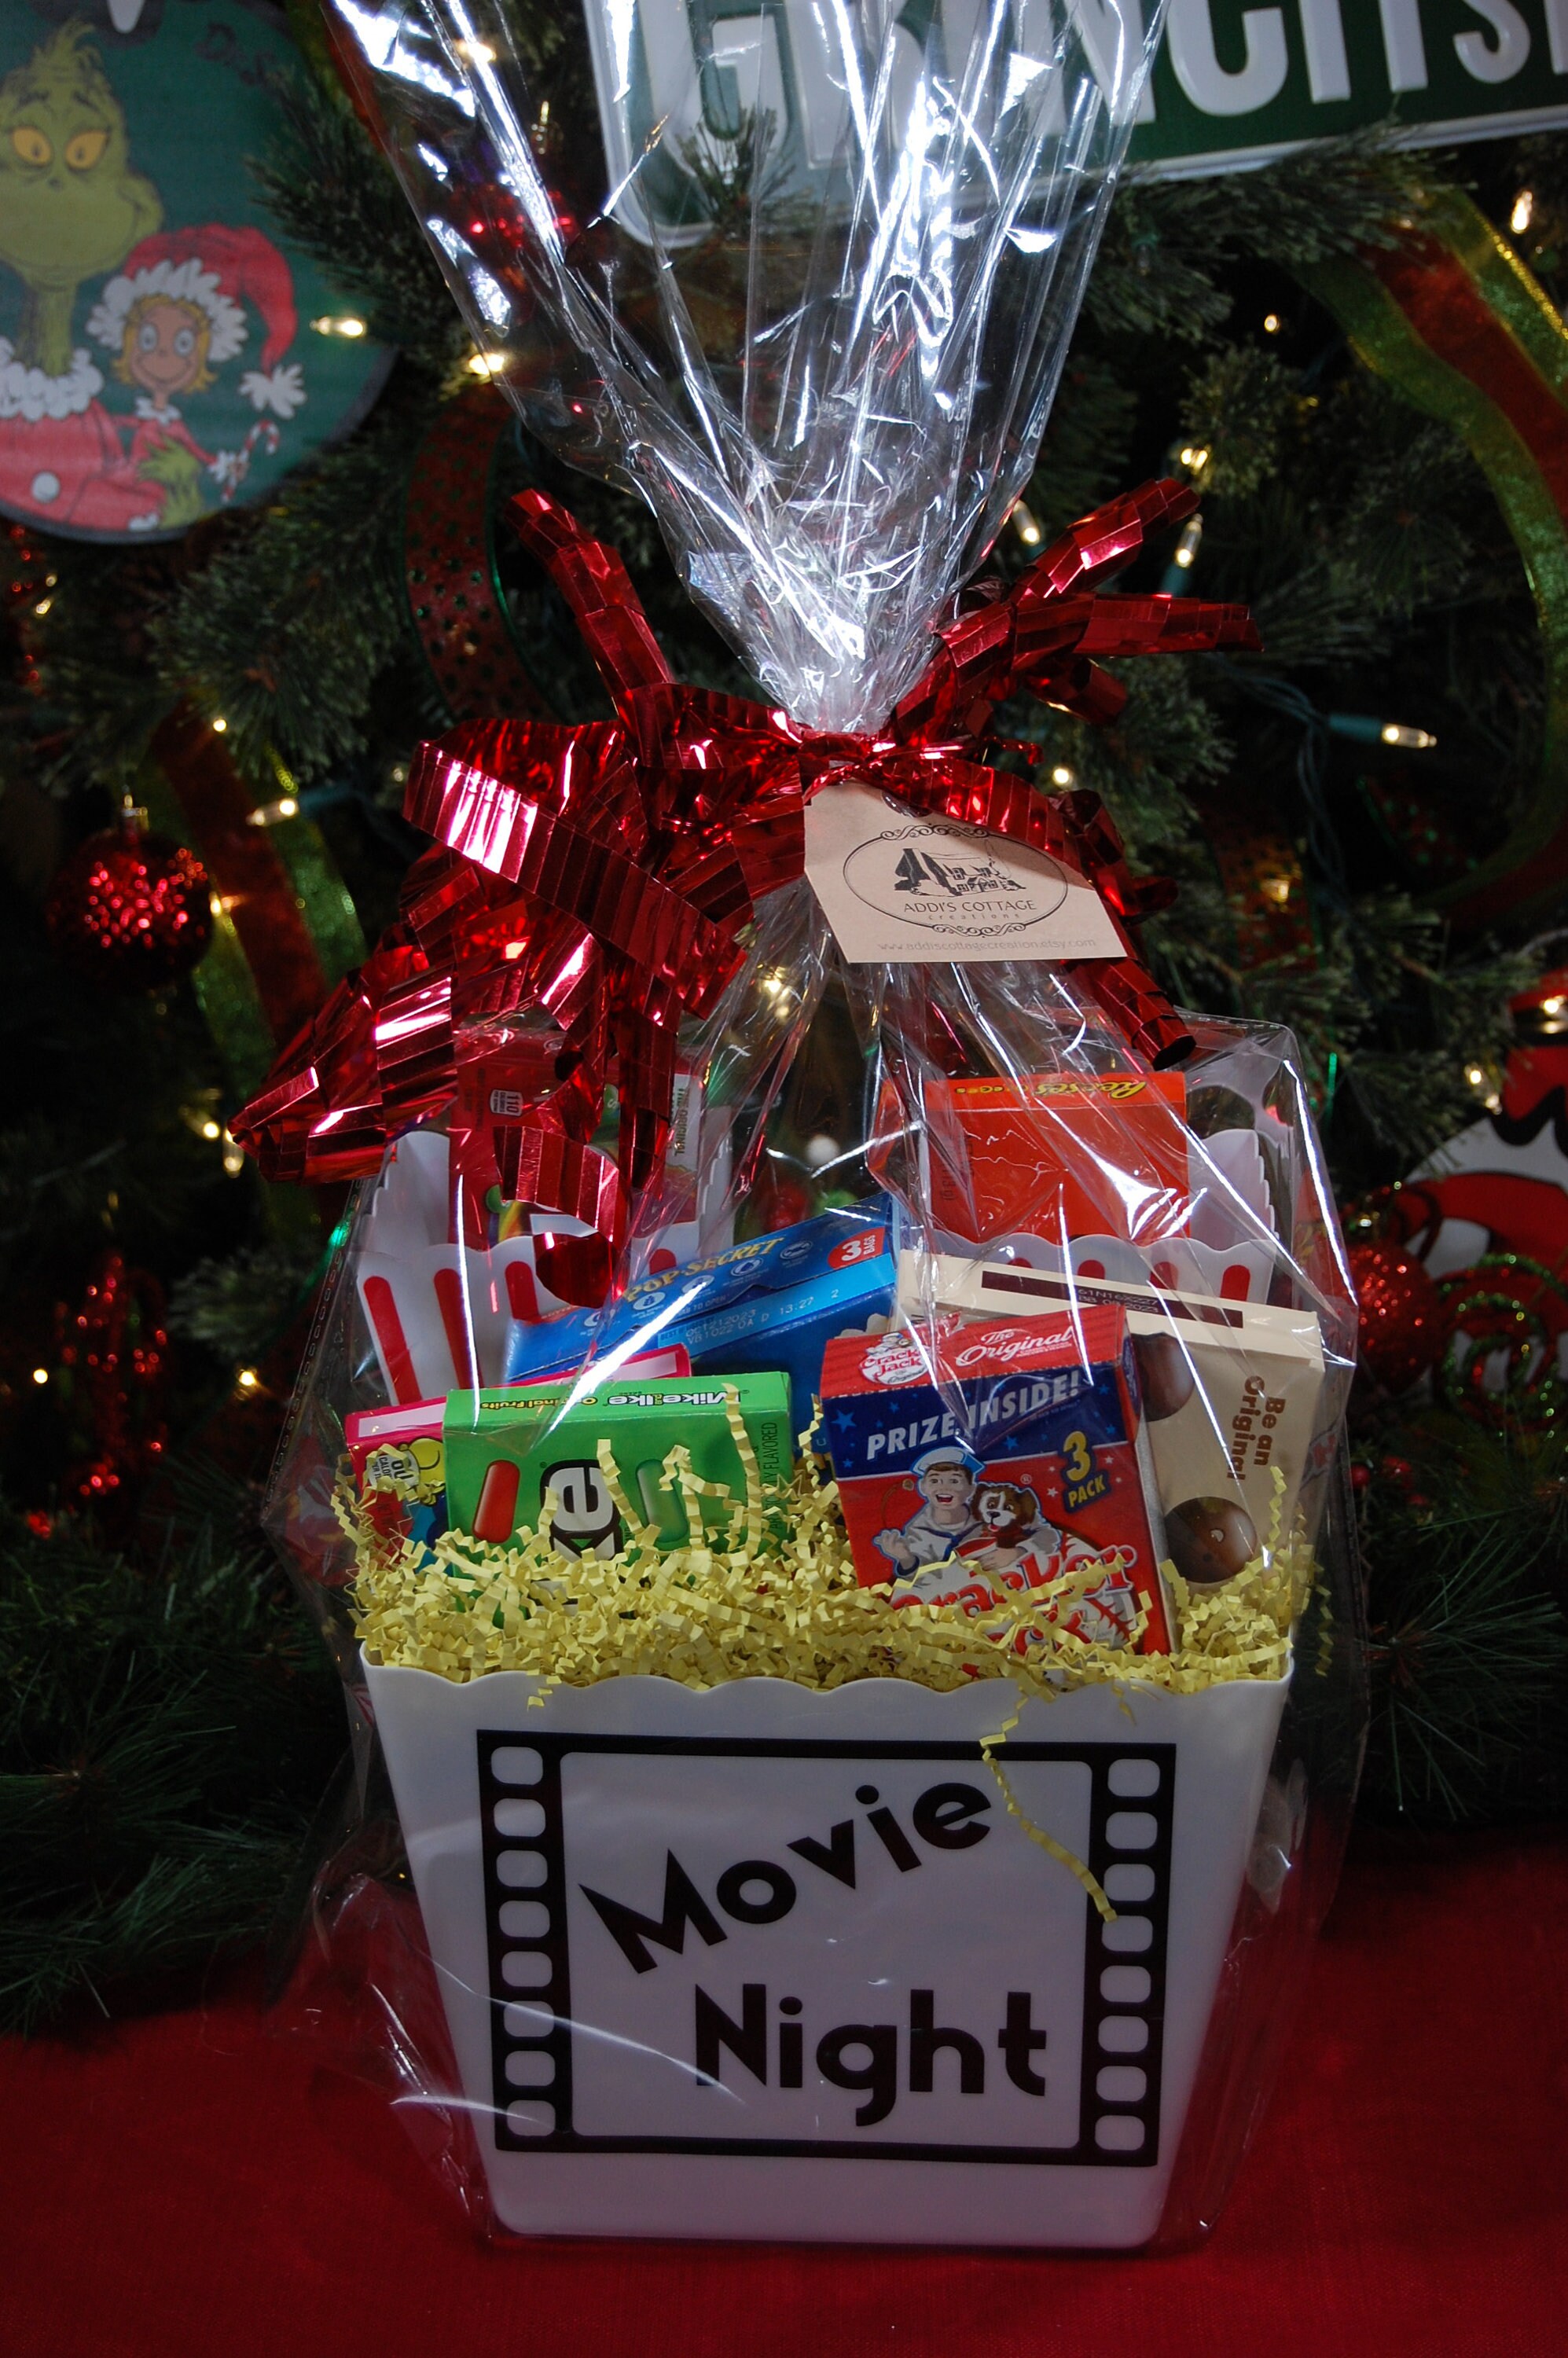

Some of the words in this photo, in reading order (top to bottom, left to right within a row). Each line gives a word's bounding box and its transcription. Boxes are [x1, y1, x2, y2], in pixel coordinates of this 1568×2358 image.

[903, 900, 957, 913] ADDI'S
[961, 899, 1037, 913] COTTAGE
[506, 1095, 520, 1113] 110
[841, 1240, 862, 1262] 3
[863, 1234, 876, 1255] BAGS
[831, 1289, 839, 1298] 2
[955, 1325, 1074, 1368] Original
[980, 1328, 1016, 1346] The
[872, 1357, 924, 1381] Jack
[480, 1398, 528, 1410] Fruits
[608, 1394, 655, 1406] Ike
[1262, 1397, 1287, 1429] Be
[867, 1412, 957, 1461] PRIZE
[1225, 1376, 1265, 1481] Original
[761, 1422, 780, 1470] FLAVORED
[1064, 1430, 1092, 1478] 3
[1254, 1434, 1273, 1466] an
[1067, 1478, 1107, 1508] PACK
[578, 1781, 992, 1974] Movie
[694, 1982, 1048, 2127] Night
